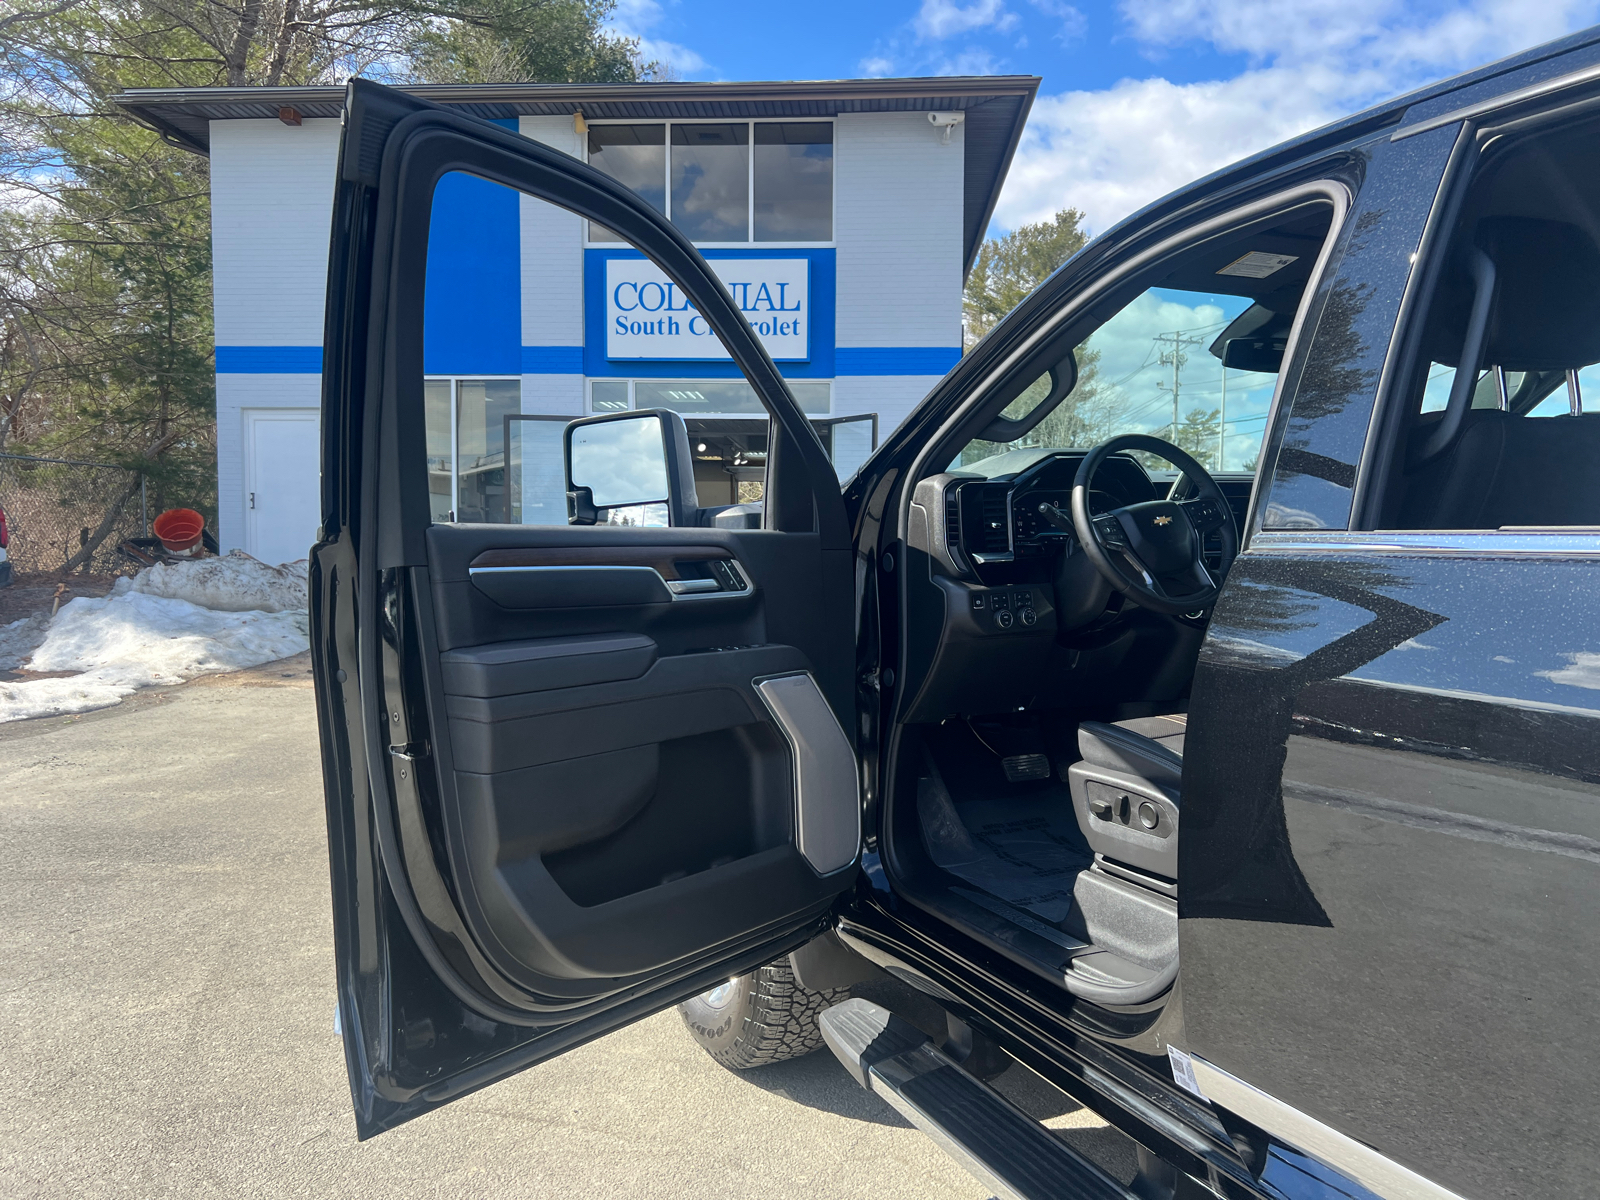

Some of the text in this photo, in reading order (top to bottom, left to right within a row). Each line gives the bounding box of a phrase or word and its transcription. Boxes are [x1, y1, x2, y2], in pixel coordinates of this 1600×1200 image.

[613, 281, 801, 312] COLIAL
[615, 315, 801, 336] South Crolet
